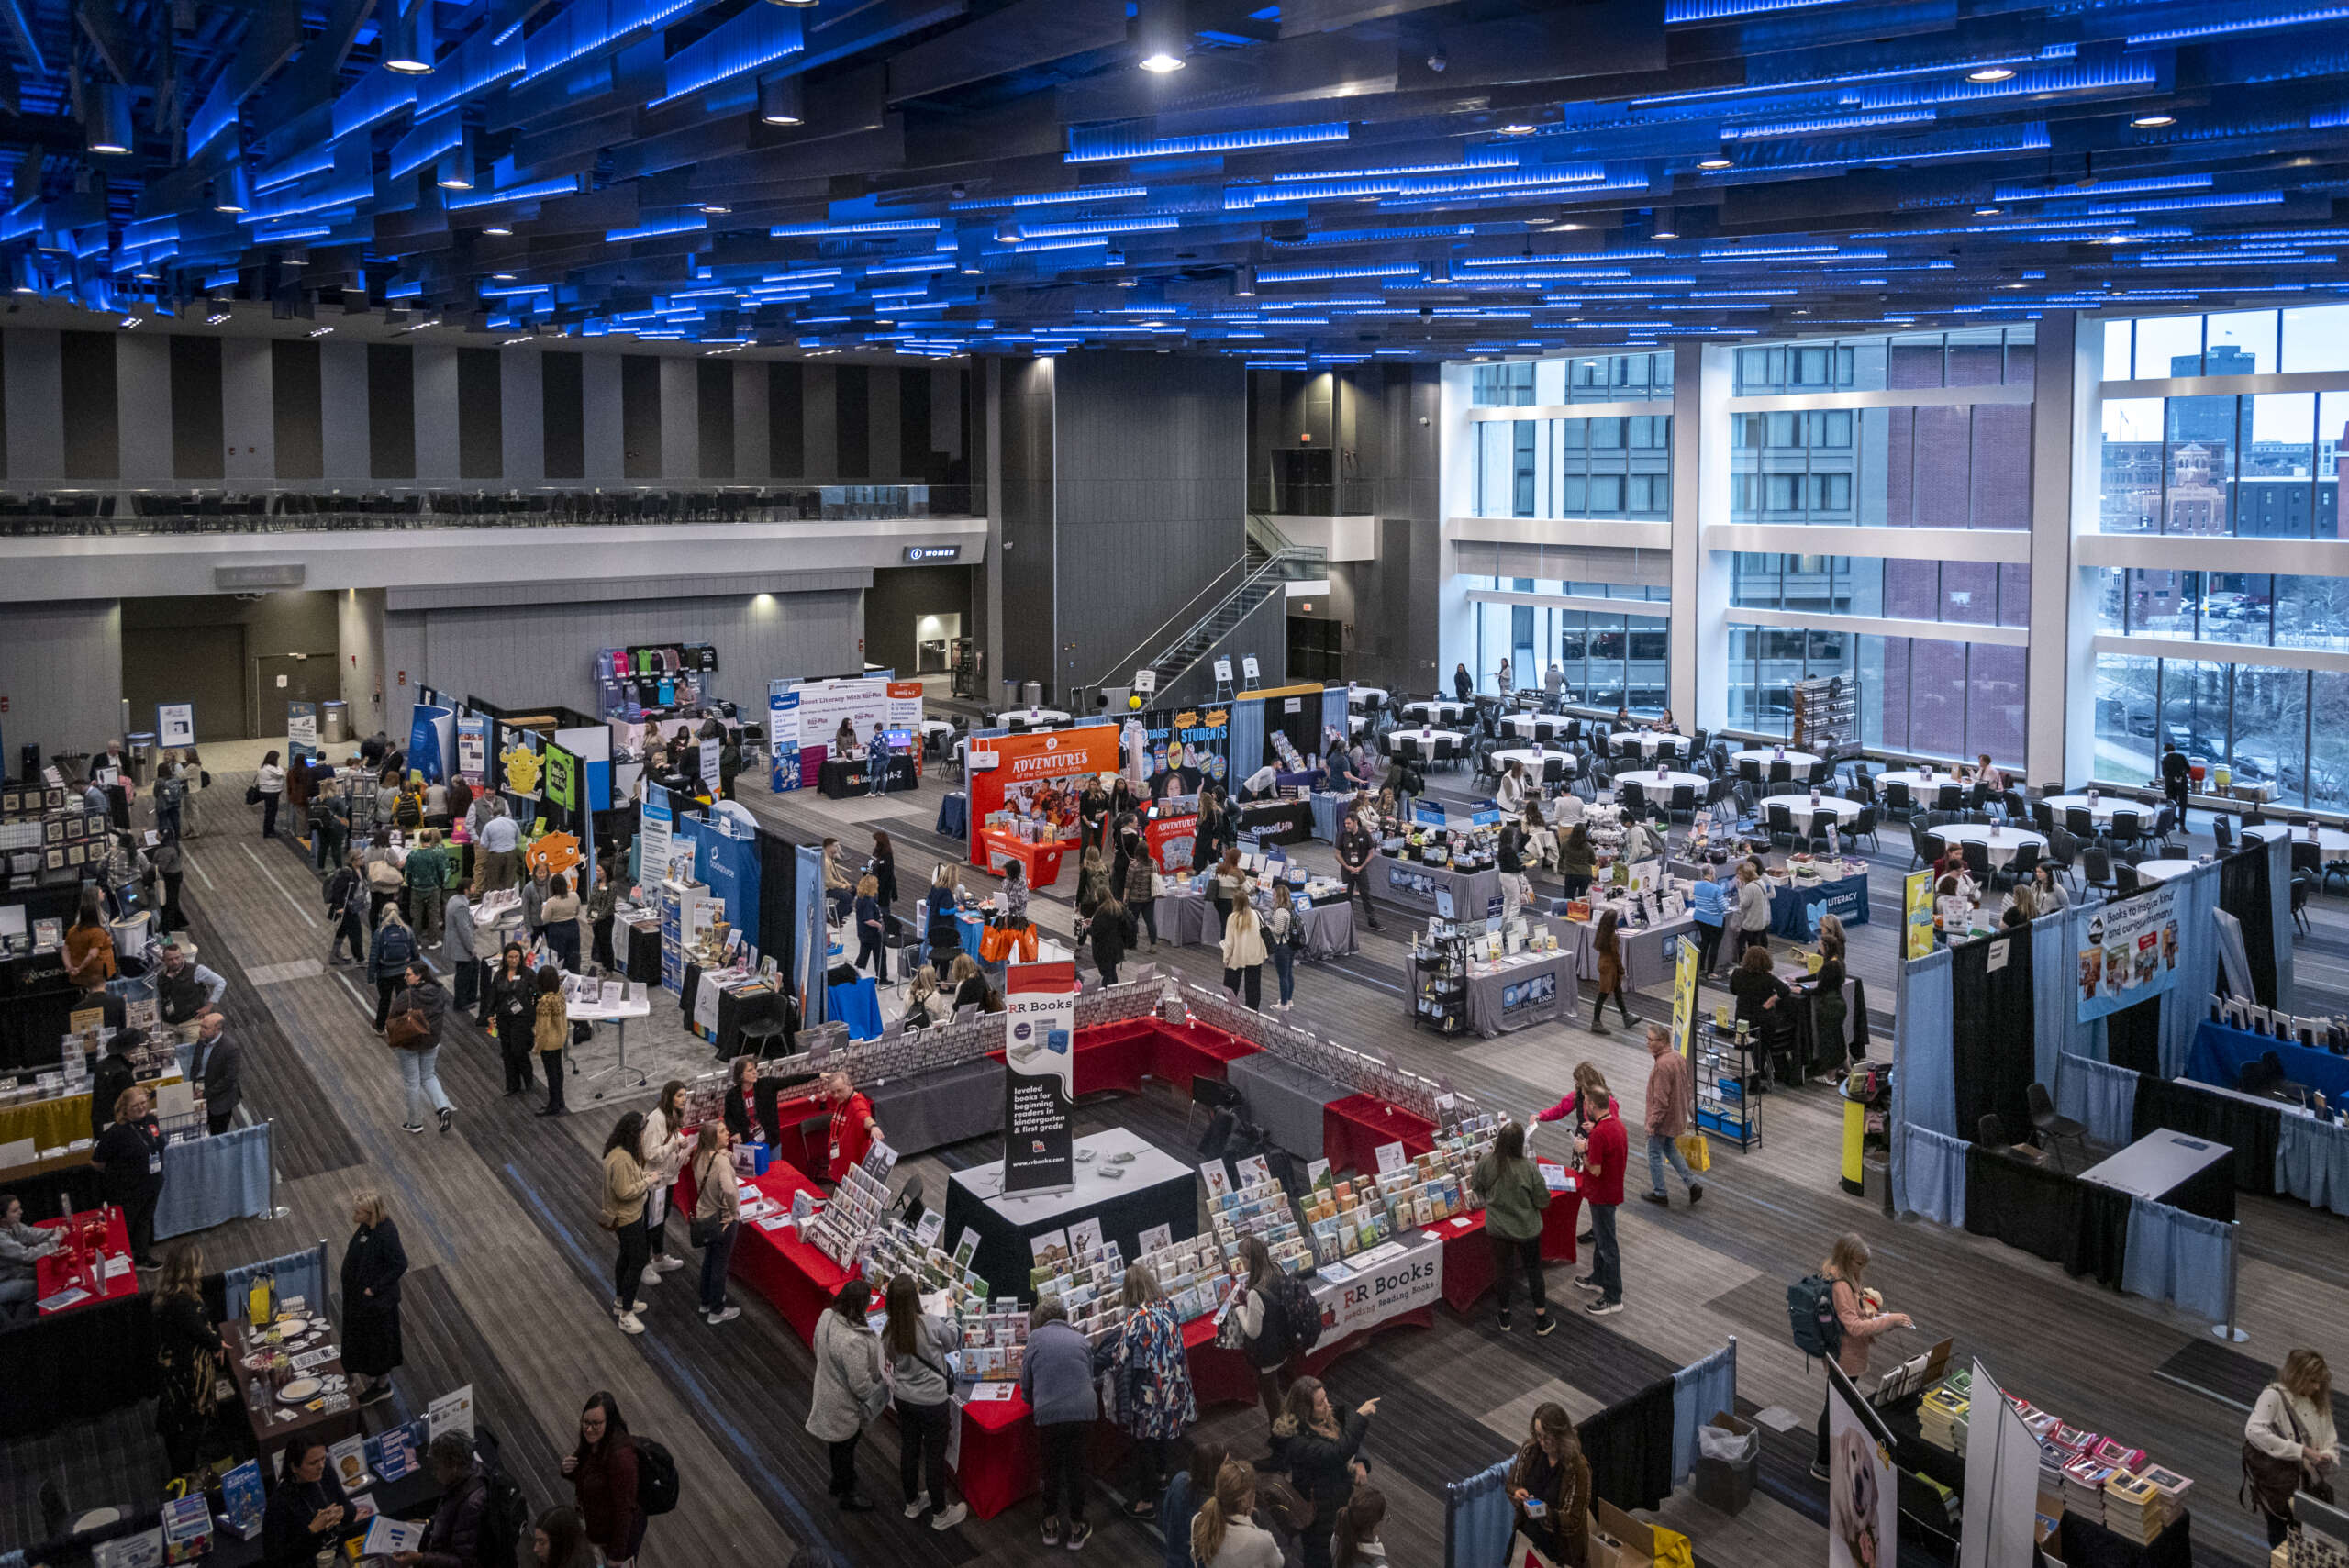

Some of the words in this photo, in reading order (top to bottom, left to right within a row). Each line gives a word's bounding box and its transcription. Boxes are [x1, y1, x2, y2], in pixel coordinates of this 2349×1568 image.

[819, 696, 845, 705] Literacy
[1181, 726, 1228, 743] STUDENTS
[1012, 751, 1088, 773] ADVENTURES
[888, 770, 902, 779] A-Z
[1035, 769, 1055, 777] Center
[1069, 765, 1082, 773] Kids
[1251, 820, 1294, 835] SchoolLife
[1828, 892, 1858, 906] LITERACY
[2107, 908, 2127, 924] Books
[2129, 906, 2137, 917] to
[2159, 890, 2175, 904] kind
[2108, 926, 2121, 939] and
[2147, 908, 2174, 923] humans
[1538, 993, 1555, 1004] BOOKS
[1008, 1003, 1027, 1014] RR
[1030, 999, 1073, 1012] Books
[1014, 1085, 1043, 1095] leveled
[1014, 1094, 1038, 1103] books
[1039, 1092, 1052, 1100] for
[1014, 1100, 1054, 1111] beginning
[1014, 1108, 1045, 1118] readers
[1046, 1107, 1054, 1116] in
[1014, 1115, 1065, 1128] kindergarten
[1014, 1126, 1020, 1135] &
[1022, 1123, 1038, 1134] first
[1040, 1121, 1063, 1133] grade
[1012, 1157, 1065, 1168] www.rrbooks.com
[1343, 1284, 1369, 1309] RR
[1375, 1262, 1434, 1296] Books
[1378, 1291, 1409, 1307] Reading
[1412, 1281, 1434, 1295] Books
